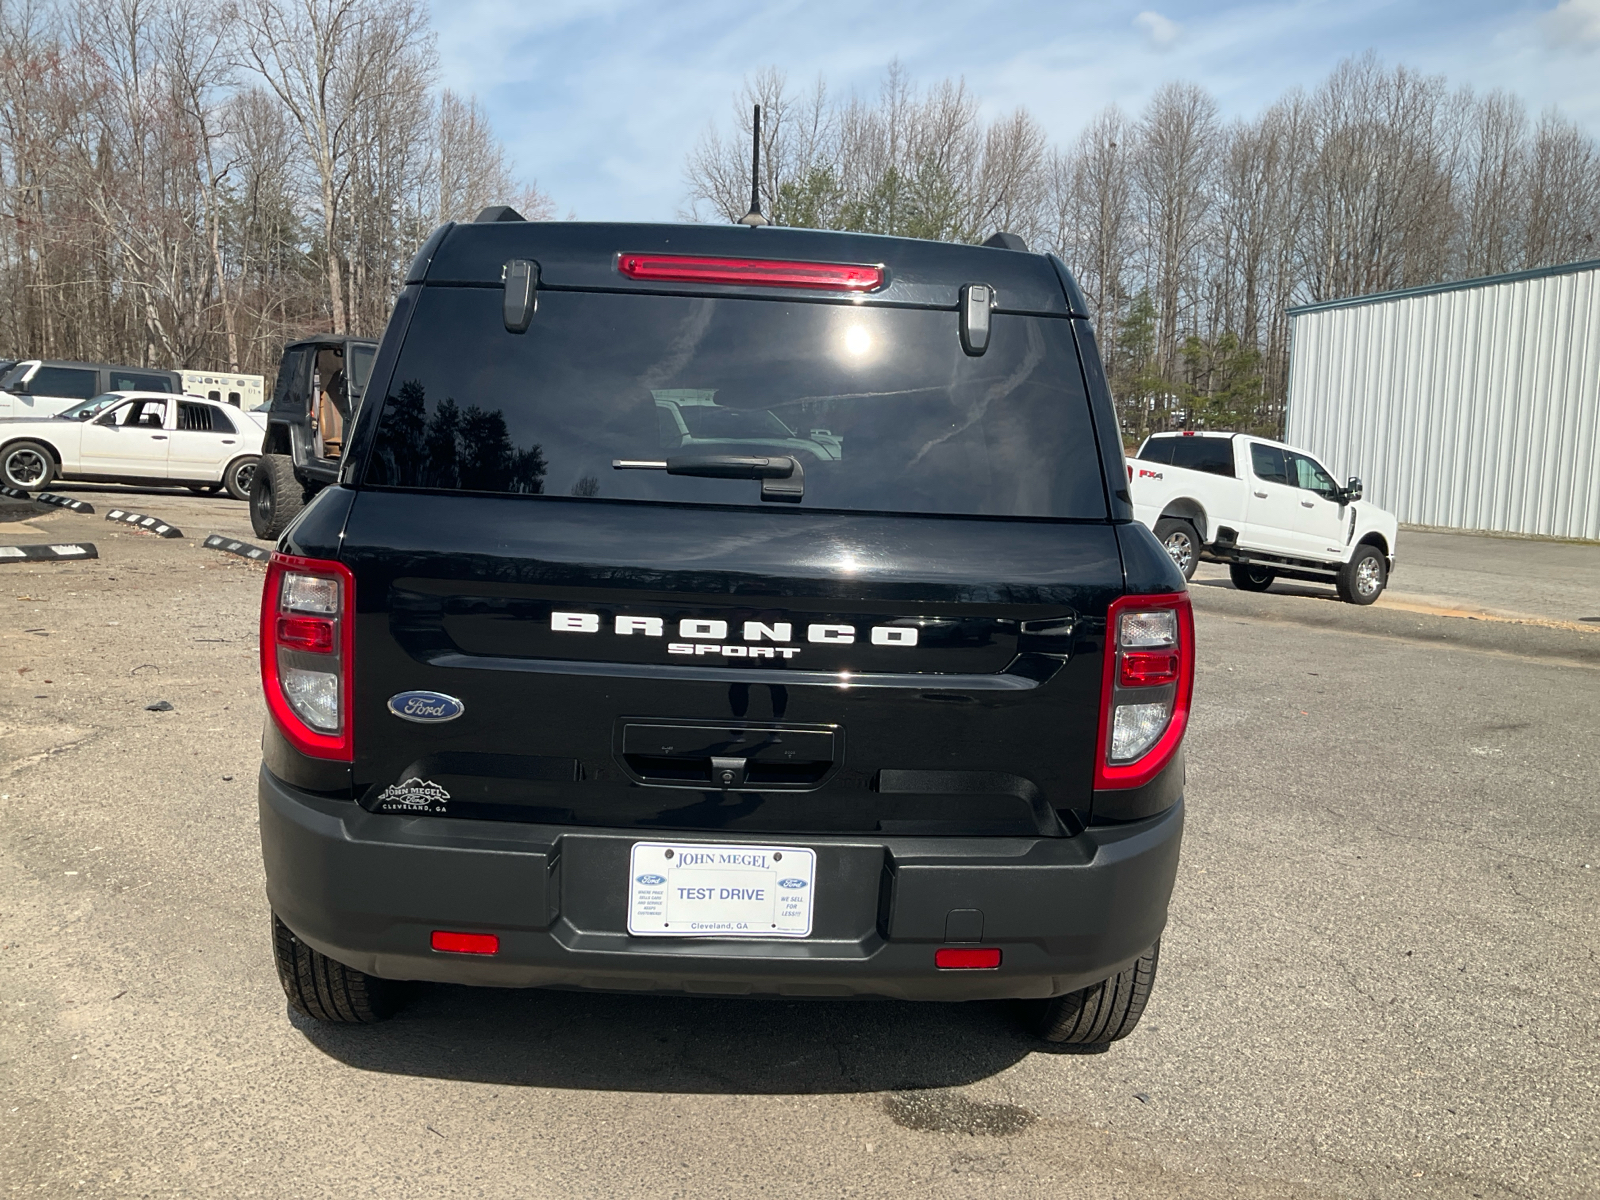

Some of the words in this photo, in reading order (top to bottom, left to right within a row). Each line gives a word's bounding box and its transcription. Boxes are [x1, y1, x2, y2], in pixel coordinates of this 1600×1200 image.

[1139, 469, 1163, 481] FX4
[551, 611, 919, 647] BRONCO
[667, 643, 801, 659] SPORT
[404, 697, 446, 716] Ford
[385, 787, 409, 797] JOHN
[410, 787, 442, 797] MEGEL
[382, 803, 432, 812] CLEVELAND,
[435, 805, 447, 813] GA
[676, 852, 716, 869] JOHN
[718, 853, 770, 870] MEGEL
[677, 887, 716, 900] TEST
[719, 887, 765, 901] DRIVE
[690, 922, 734, 930] Cleveland,
[736, 922, 749, 930] GA
